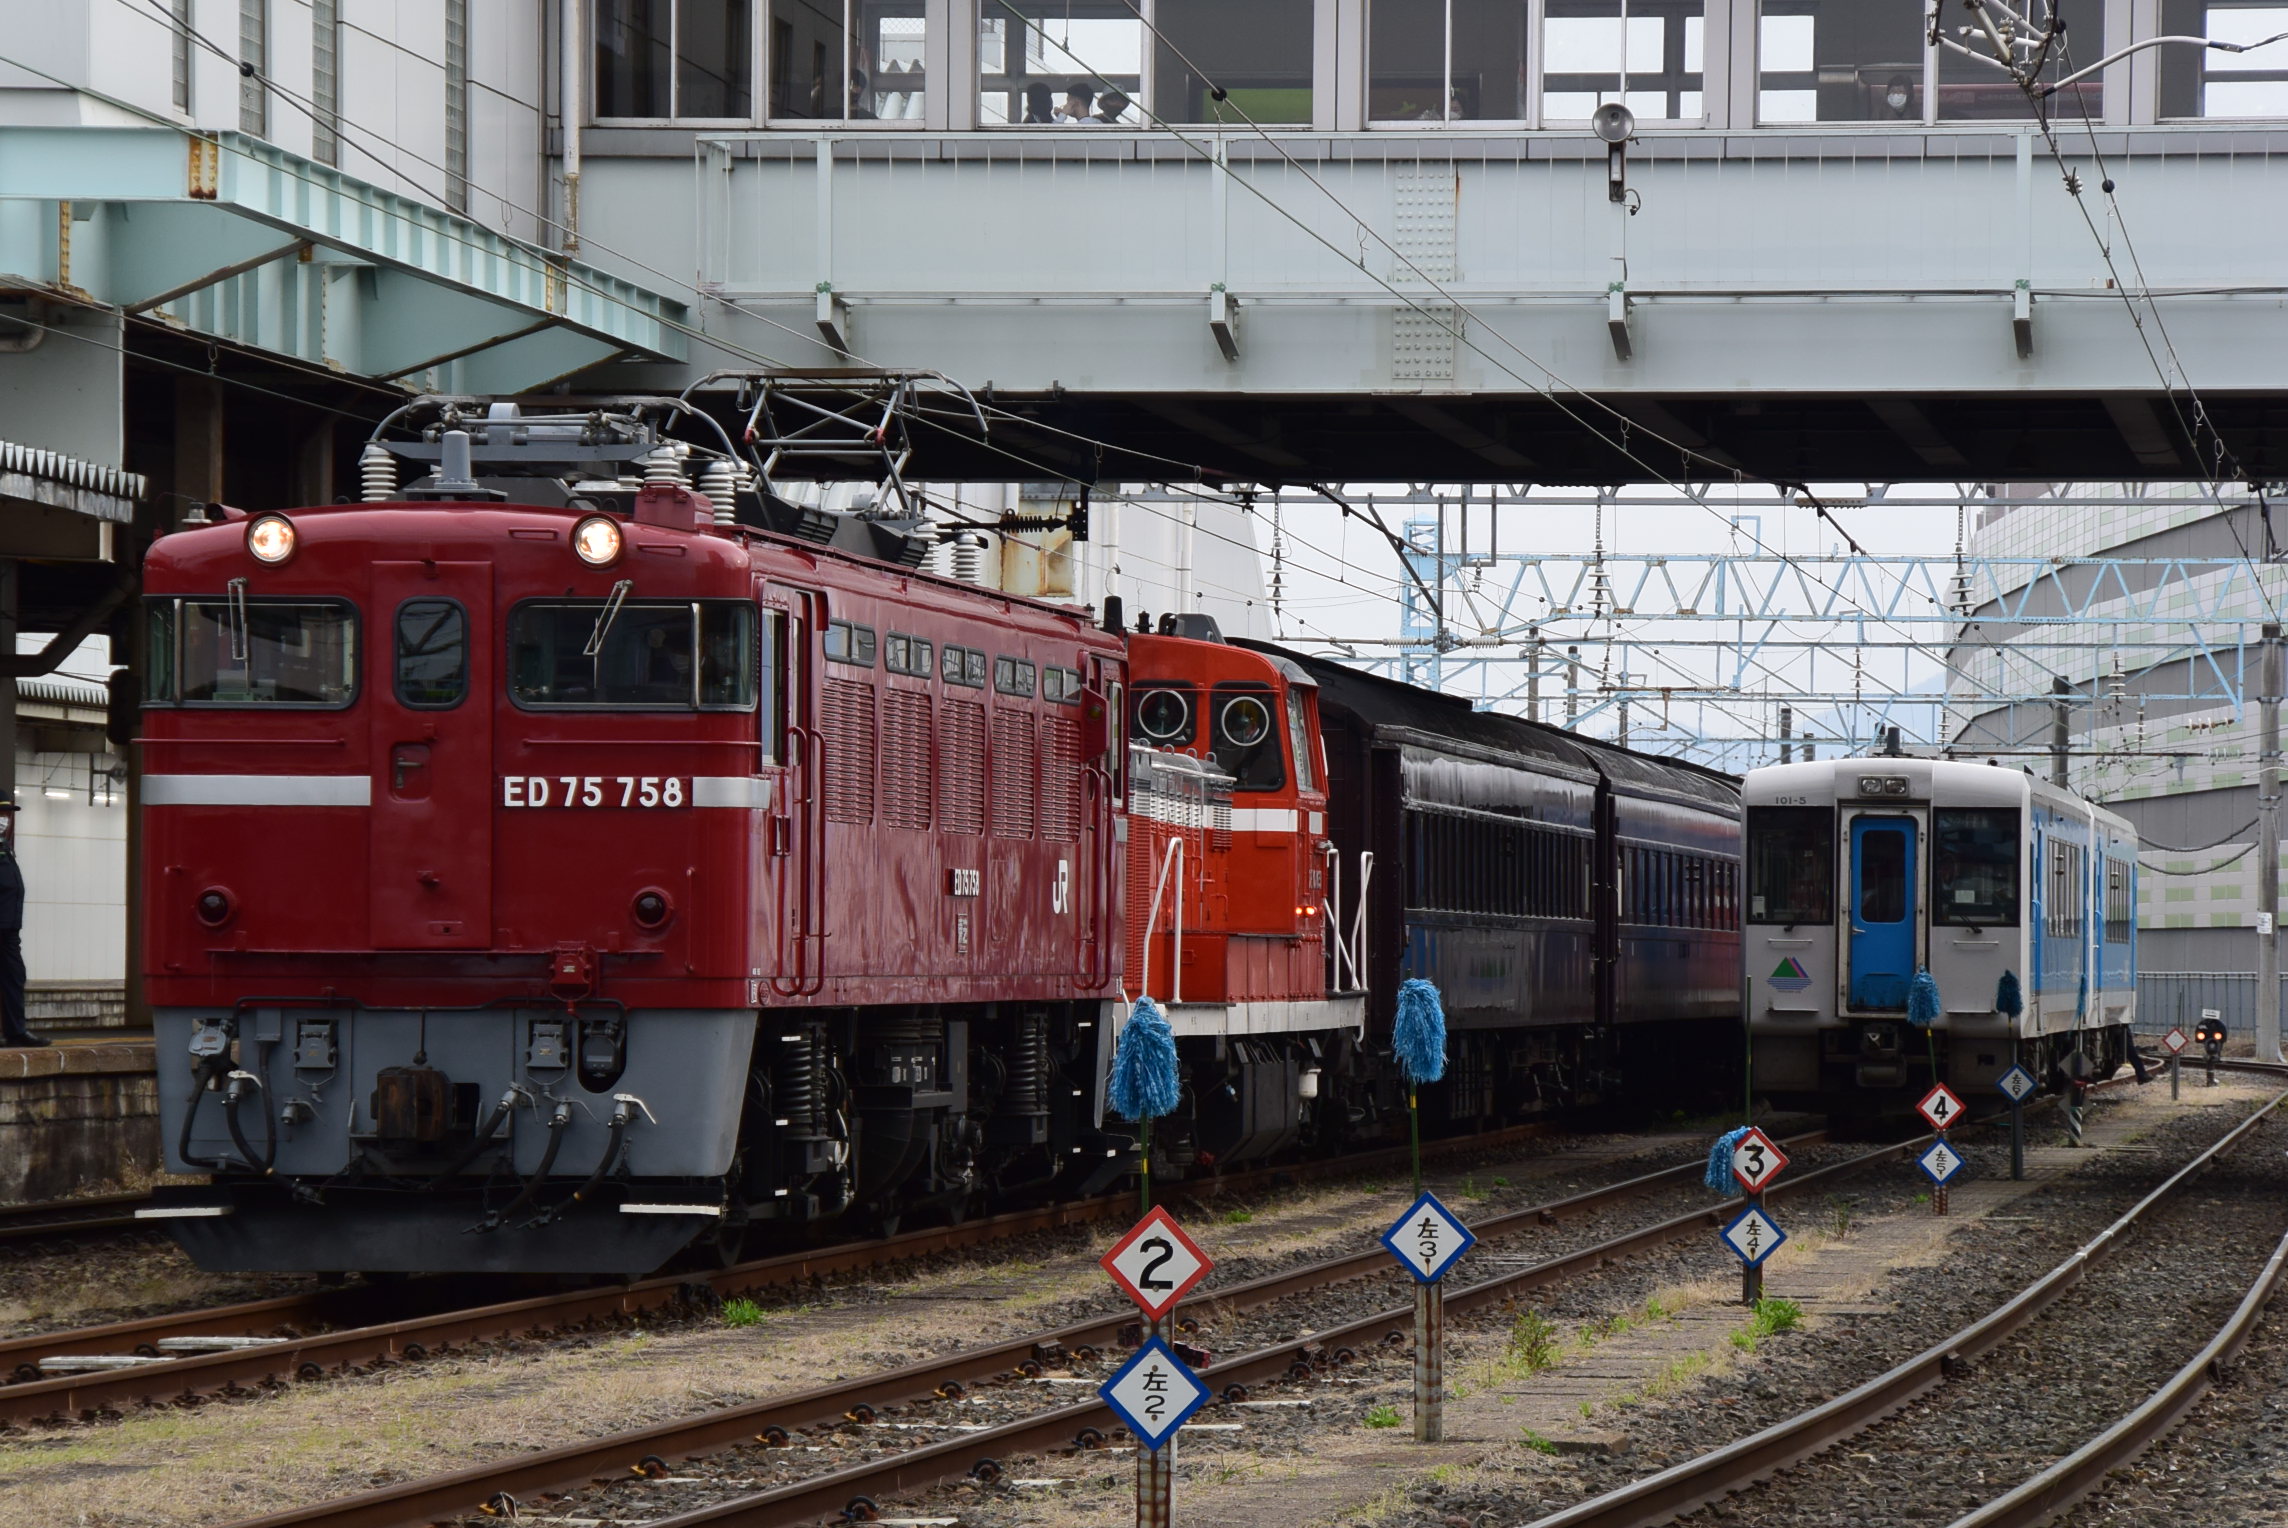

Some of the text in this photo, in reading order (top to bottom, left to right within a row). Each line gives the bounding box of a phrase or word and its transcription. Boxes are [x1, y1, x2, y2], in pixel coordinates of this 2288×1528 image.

[503, 776, 683, 807] ED 75 758
[1775, 796, 1807, 805] 101-5
[1052, 859, 1068, 915] JR
[1933, 1096, 1949, 1119] 4
[1744, 1145, 1765, 1178] 3
[1138, 1238, 1174, 1290] 2
